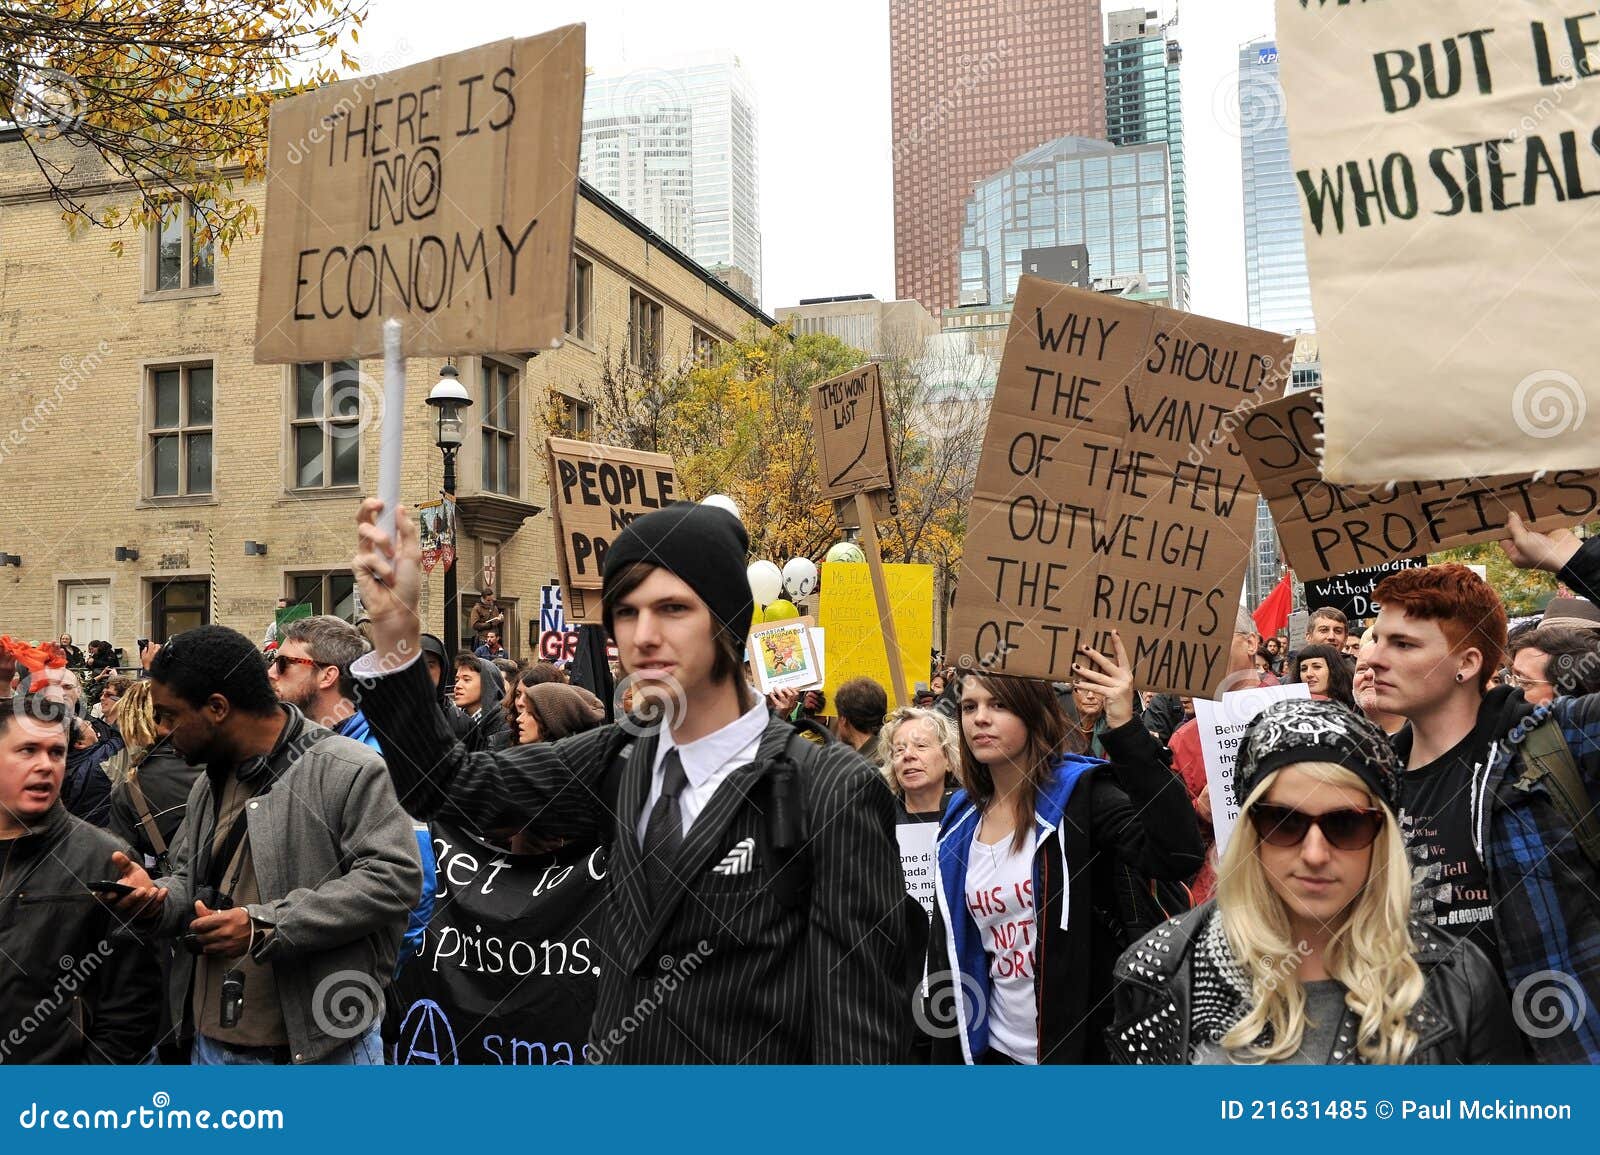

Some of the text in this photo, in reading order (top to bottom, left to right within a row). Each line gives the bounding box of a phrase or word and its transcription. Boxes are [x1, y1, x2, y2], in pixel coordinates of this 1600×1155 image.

[1374, 10, 1600, 113] BUT LE
[324, 67, 516, 167] THERE IS
[369, 146, 441, 231] NO
[1296, 124, 1600, 236] WHO STEAL
[294, 219, 537, 320] ECONOMY
[1036, 307, 1265, 394] WHY SHOULD
[819, 372, 868, 410] THIS WONT
[834, 400, 857, 430] LAST
[1025, 365, 1101, 423] THE
[557, 459, 677, 508] PEOPLE
[1009, 432, 1061, 479] OF
[1083, 443, 1157, 499] THE
[1168, 461, 1246, 518] FEW
[1008, 495, 1208, 571] OUTWEIGH
[1311, 469, 1597, 571] PROFITS
[987, 556, 1067, 613] THE
[1093, 574, 1224, 637] RIGHTS
[1316, 579, 1377, 596] Without
[975, 620, 1221, 691] OF THE MANY
[1222, 768, 1232, 778] of
[1429, 845, 1446, 855] We
[1442, 861, 1469, 877] Tell
[966, 886, 1006, 918] HIS
[1454, 885, 1489, 900] You
[432, 924, 601, 977] prisons,
[990, 920, 1033, 949] NOT
